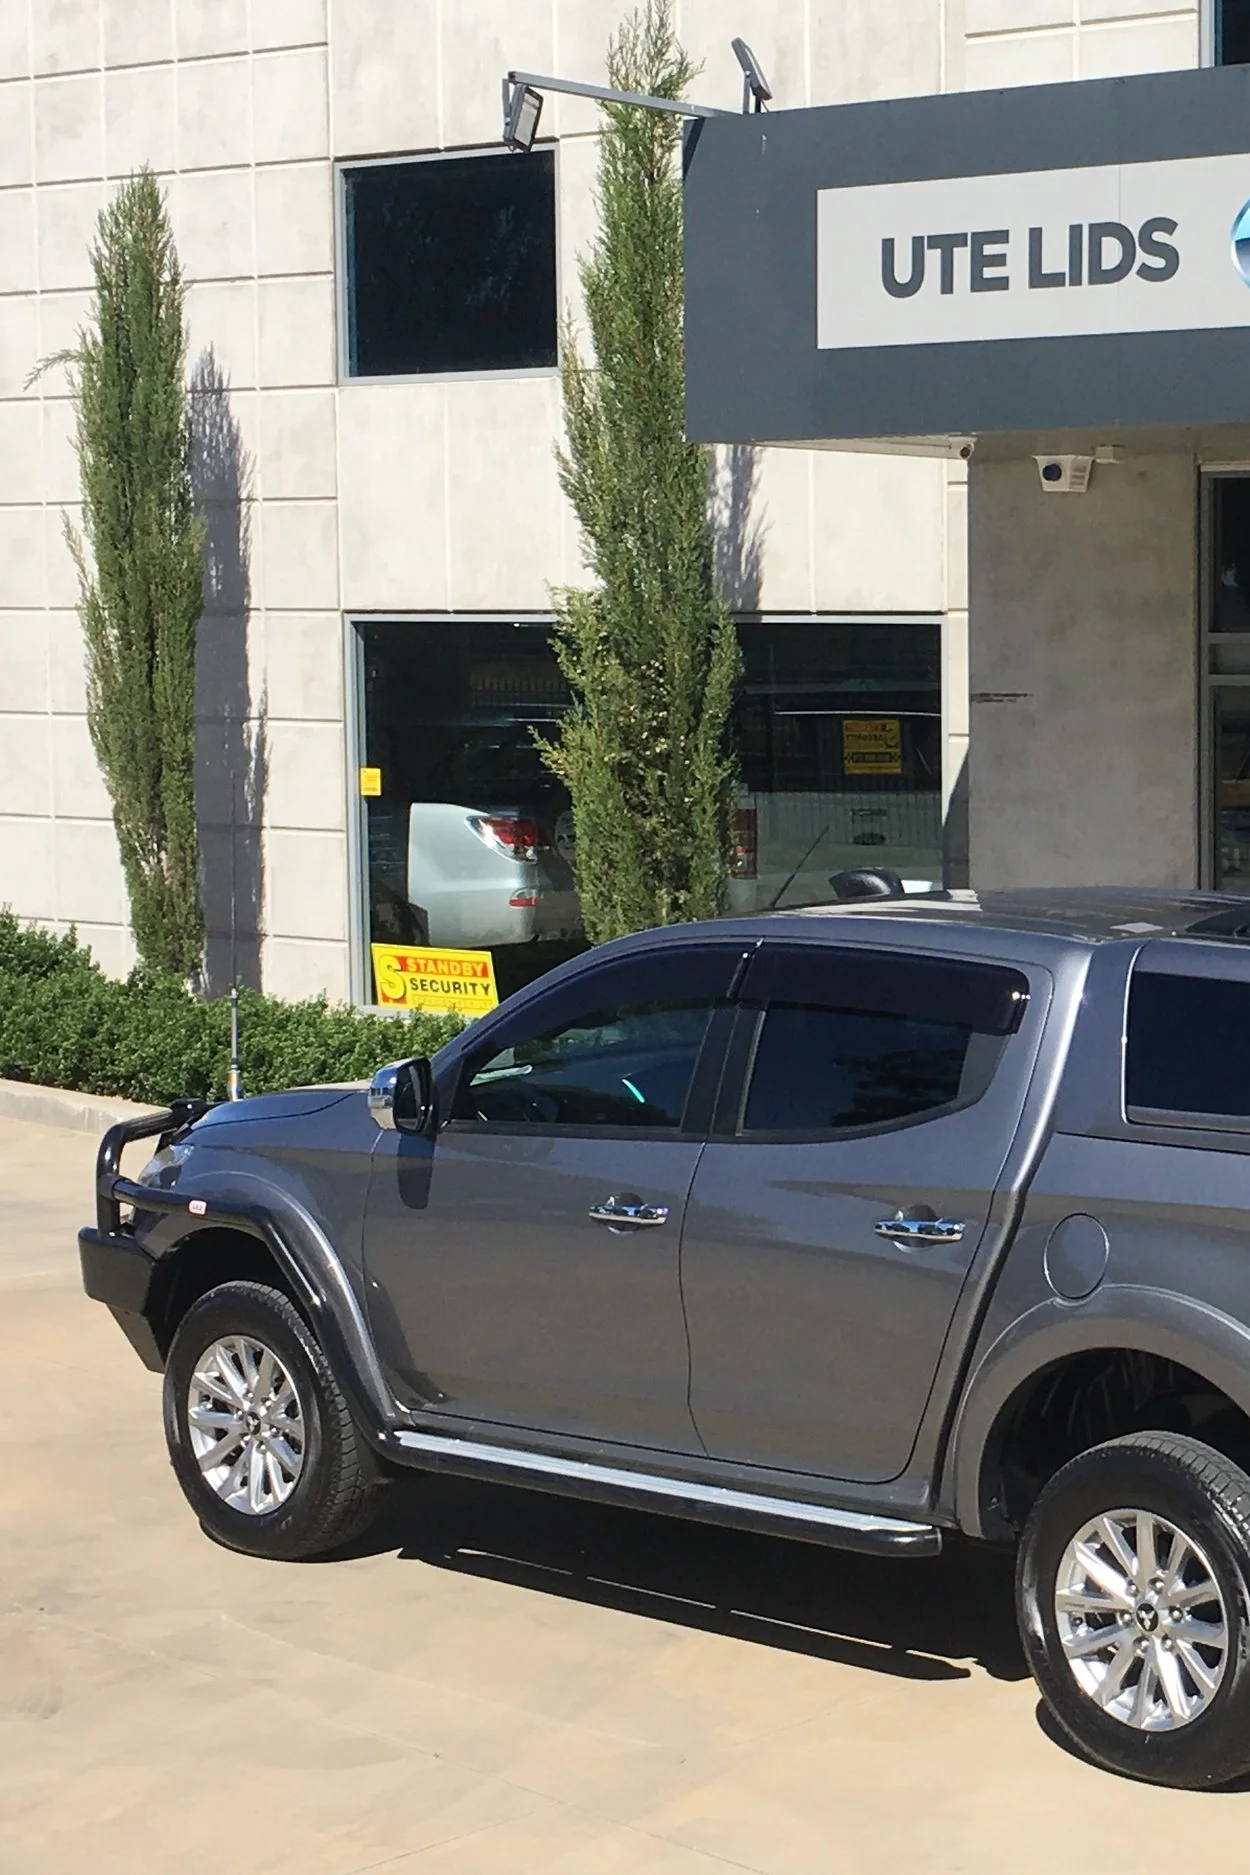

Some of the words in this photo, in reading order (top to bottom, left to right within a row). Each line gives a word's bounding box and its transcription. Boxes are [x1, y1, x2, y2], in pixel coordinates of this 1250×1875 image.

[881, 229, 1009, 298] UTE
[1028, 217, 1180, 290] LIDS
[405, 957, 484, 976] STANDBY
[409, 977, 491, 996] SECURITY
